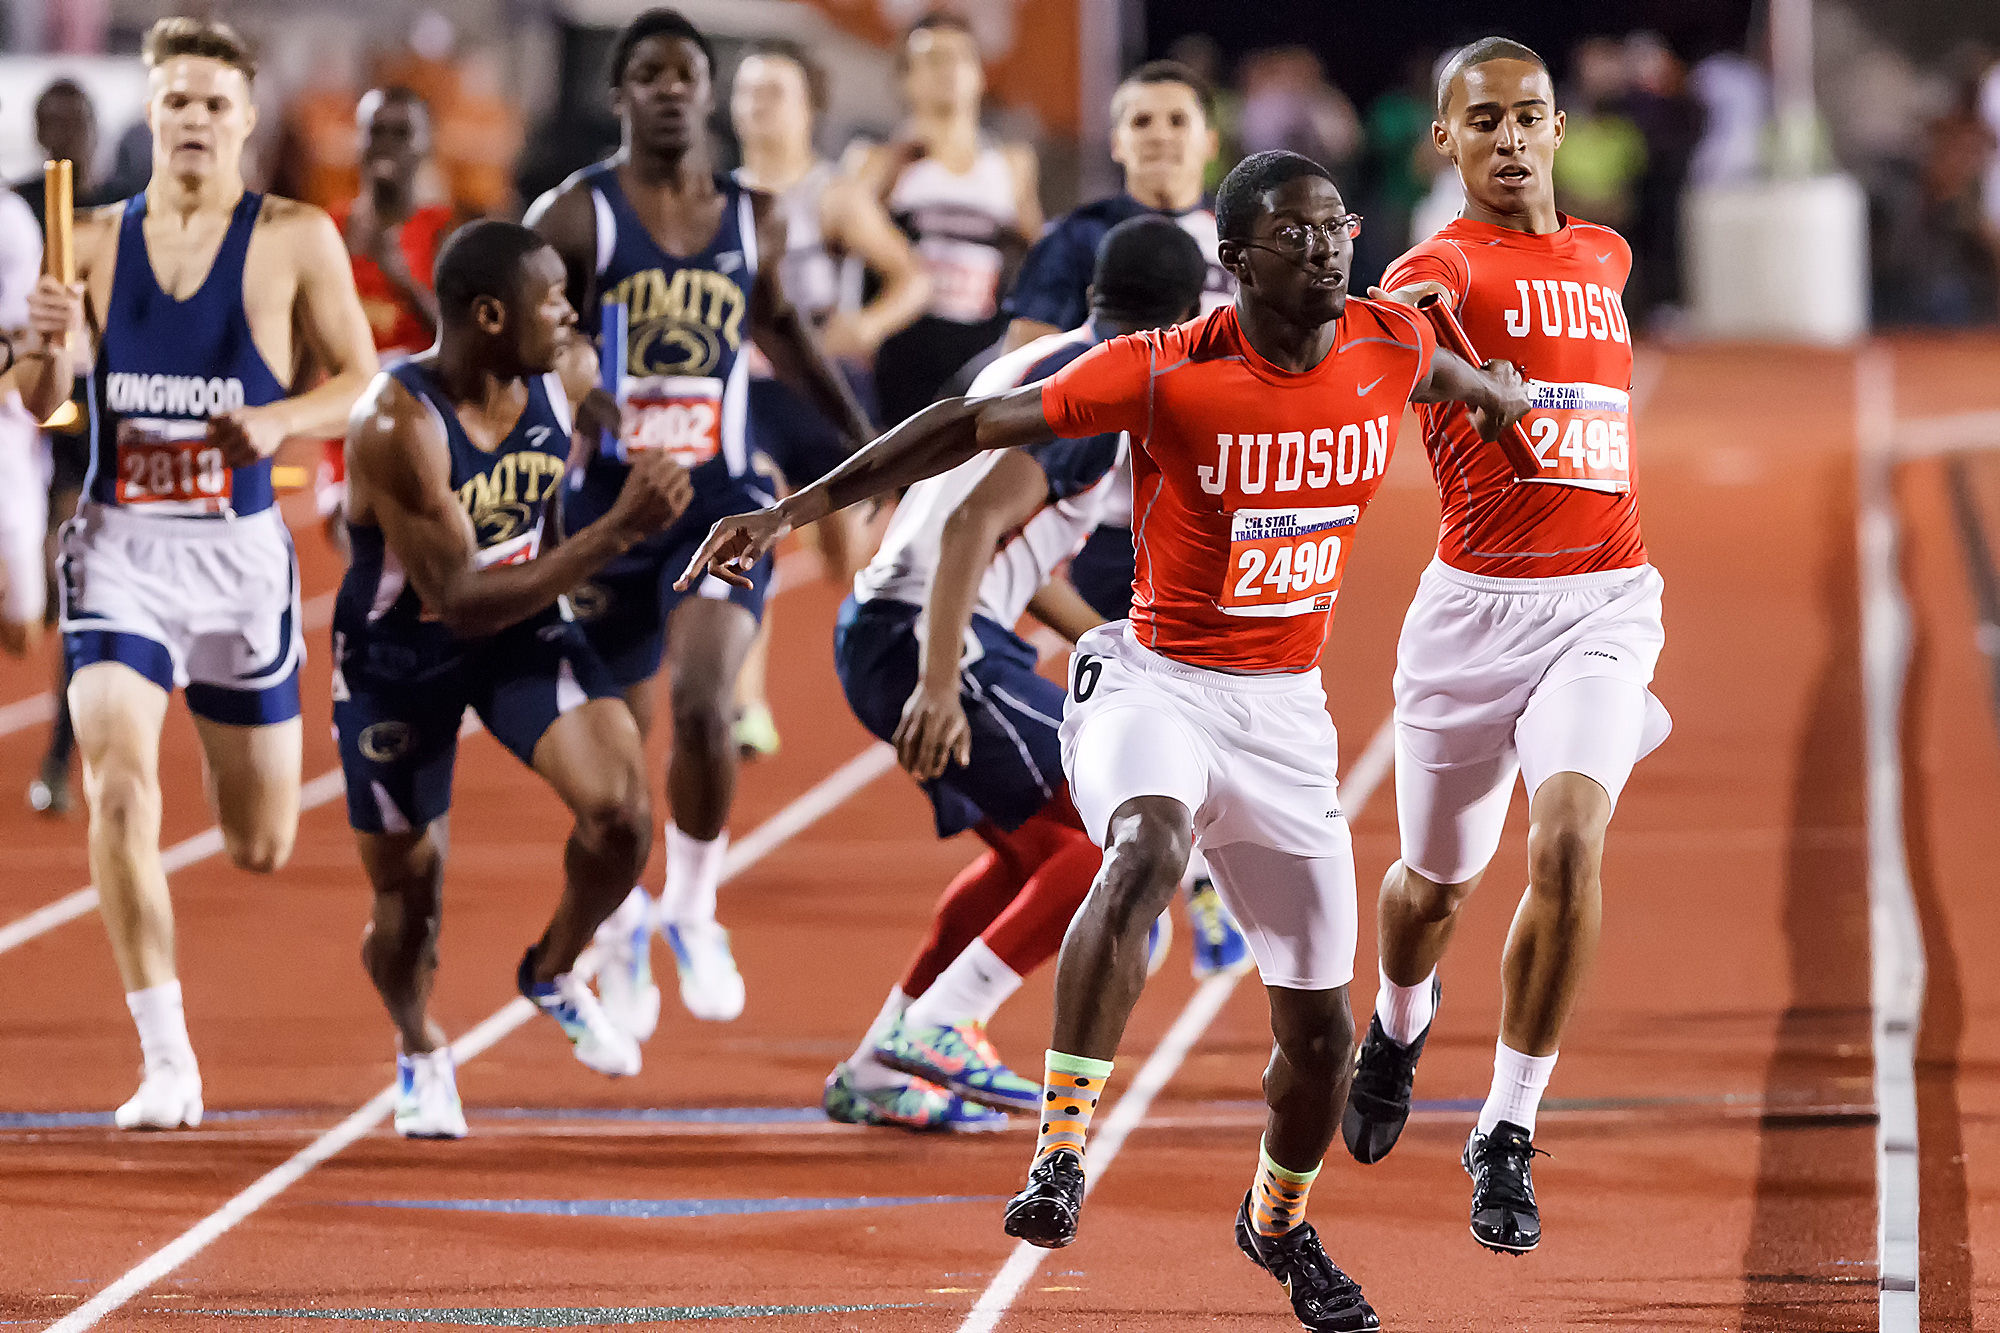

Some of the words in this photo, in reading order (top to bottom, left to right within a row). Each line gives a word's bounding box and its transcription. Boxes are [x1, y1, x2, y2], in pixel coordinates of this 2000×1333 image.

[106, 372, 244, 415] KINGWOOD
[1530, 399, 1554, 410] RACK
[1563, 400, 1583, 410] FIELD
[1557, 387, 1585, 399] STATE
[1197, 415, 1389, 495] JUDSON
[1530, 417, 1629, 471] 2495
[1235, 530, 1262, 541] TRACK
[1271, 527, 1294, 538] FIELD
[1295, 516, 1354, 536] CHAMPIONSHIPS
[1265, 514, 1297, 528] STATE
[1233, 535, 1341, 597] 2490
[1073, 654, 1102, 703] 6
